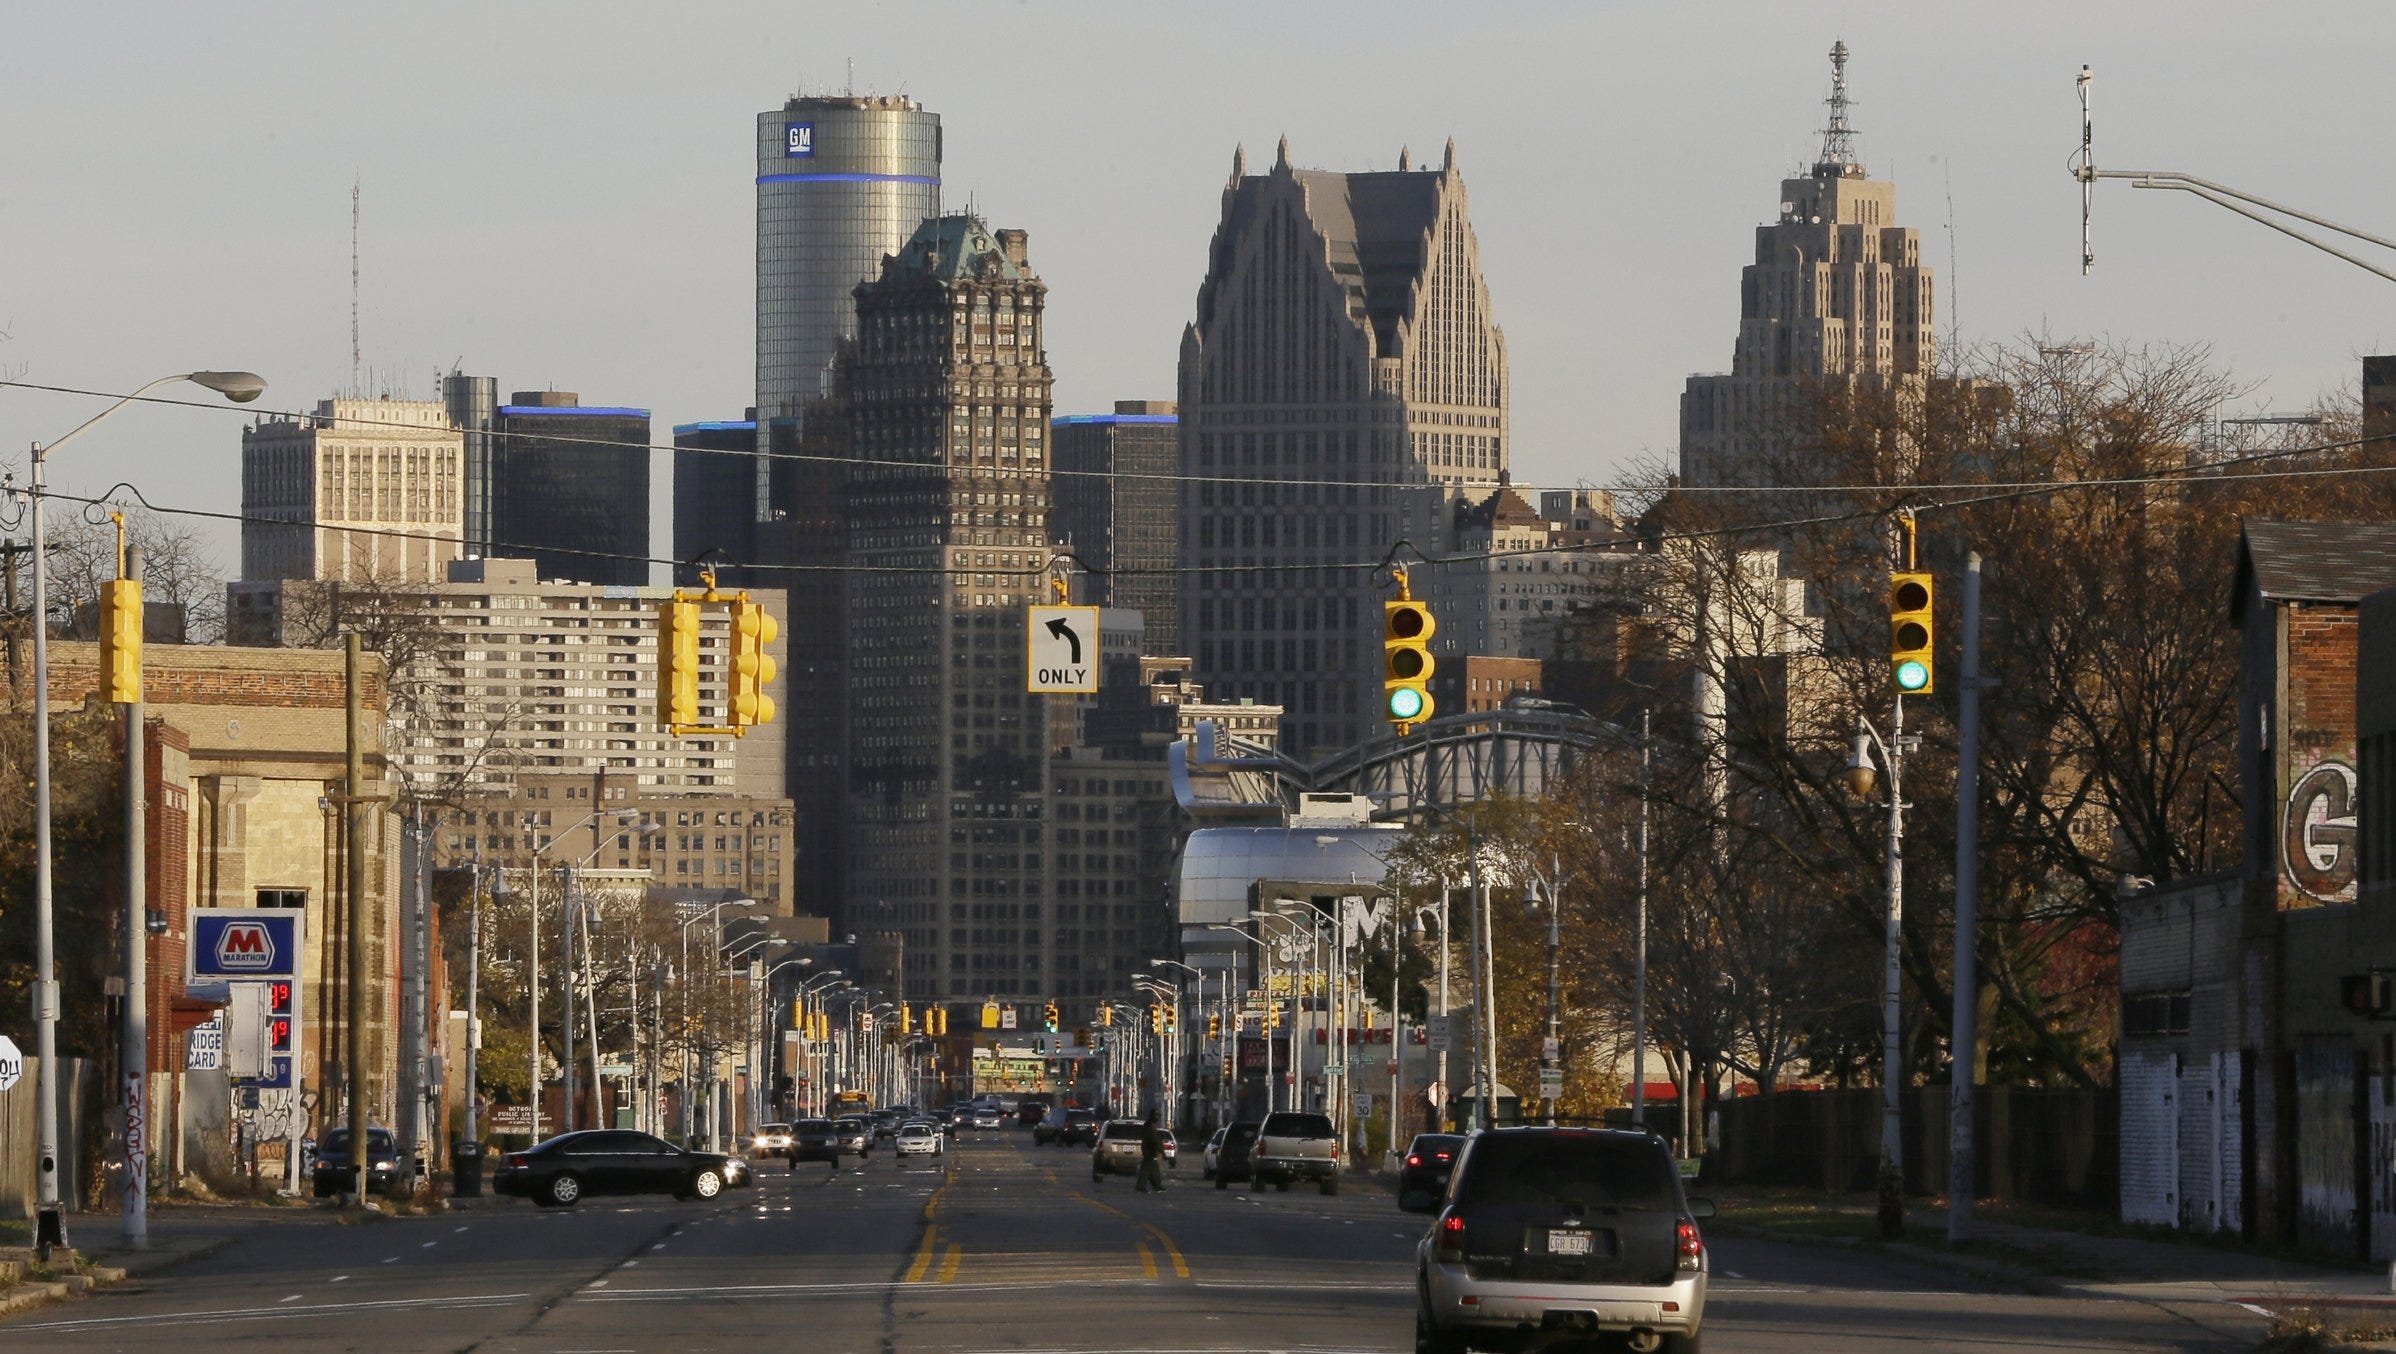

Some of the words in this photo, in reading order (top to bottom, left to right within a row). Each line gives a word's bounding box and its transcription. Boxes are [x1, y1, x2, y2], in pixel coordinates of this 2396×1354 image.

[790, 128, 811, 147] GM
[1038, 668, 1087, 684] ONLY
[223, 954, 267, 962] MARATHON
[187, 1052, 216, 1068] CARD
